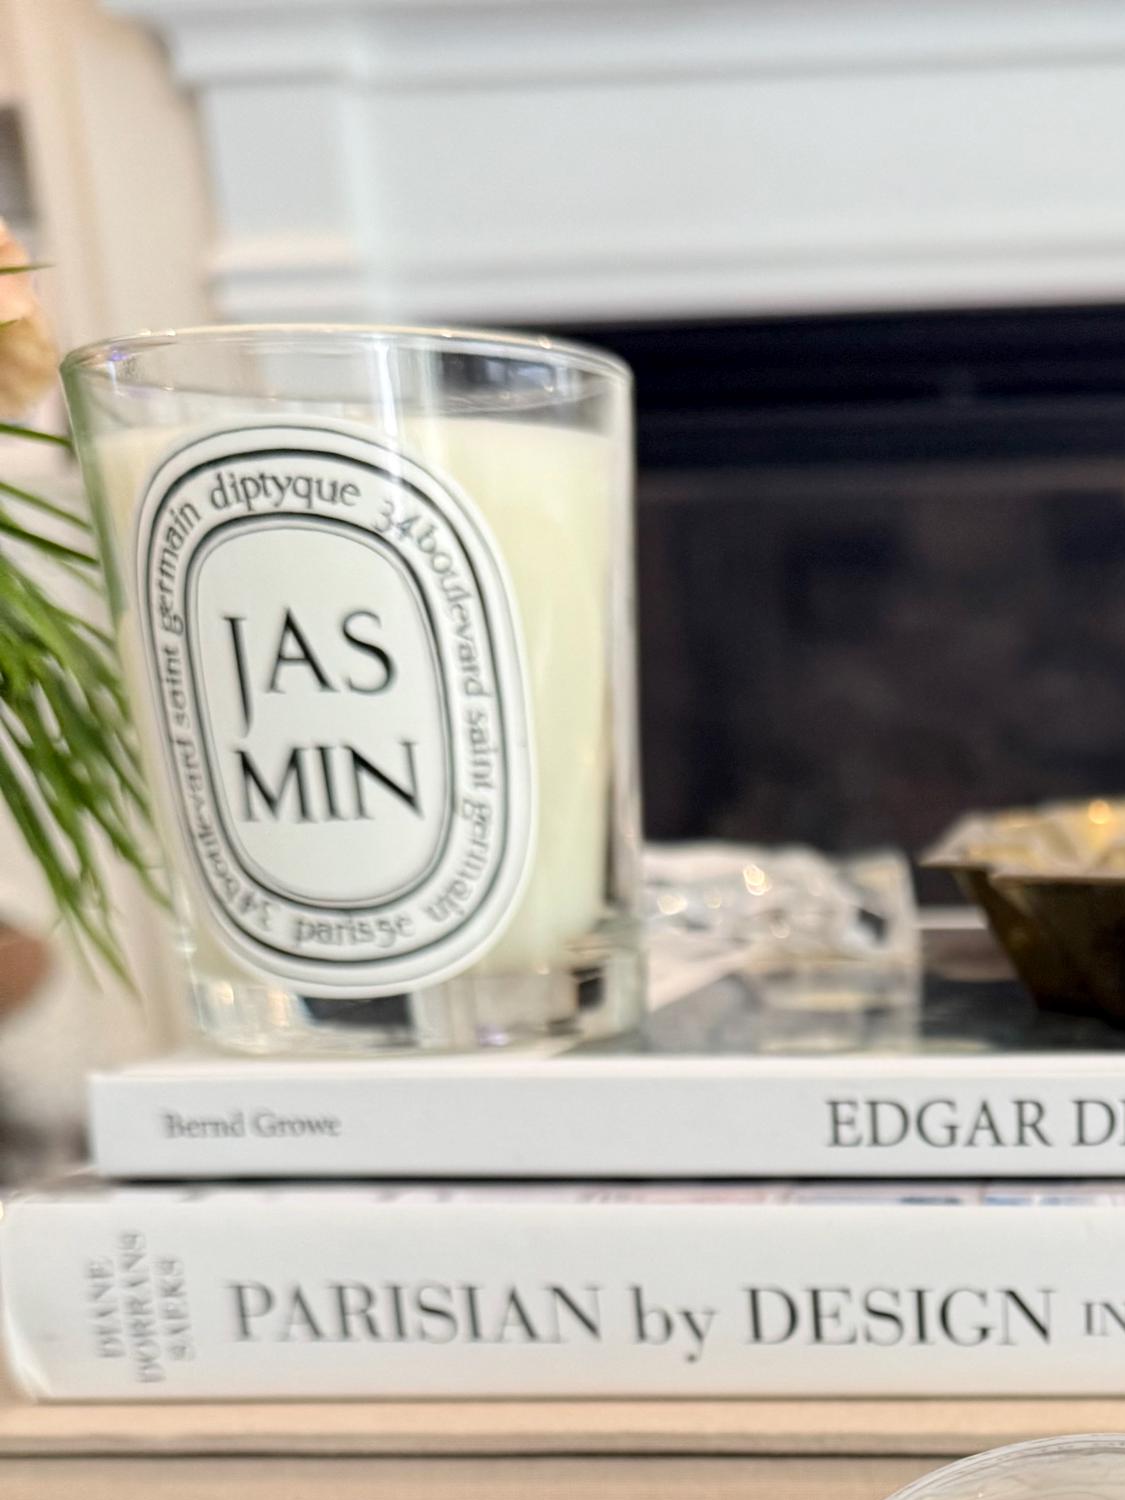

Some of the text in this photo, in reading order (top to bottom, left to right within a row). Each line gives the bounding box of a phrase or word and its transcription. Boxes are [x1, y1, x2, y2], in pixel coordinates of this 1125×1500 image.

[209, 470, 361, 512] diptyque
[157, 499, 202, 637] germain
[161, 646, 192, 729] saint
[222, 606, 398, 739] JAS
[234, 739, 426, 824] MIN
[464, 706, 496, 790] saint
[420, 798, 492, 923] germain
[163, 1110, 342, 1138] Bernd Growe
[824, 1097, 1053, 1149] EDGAR
[226, 1281, 604, 1345] PARISIAN
[630, 1285, 717, 1363] by
[742, 1286, 1056, 1347] DESIGN
